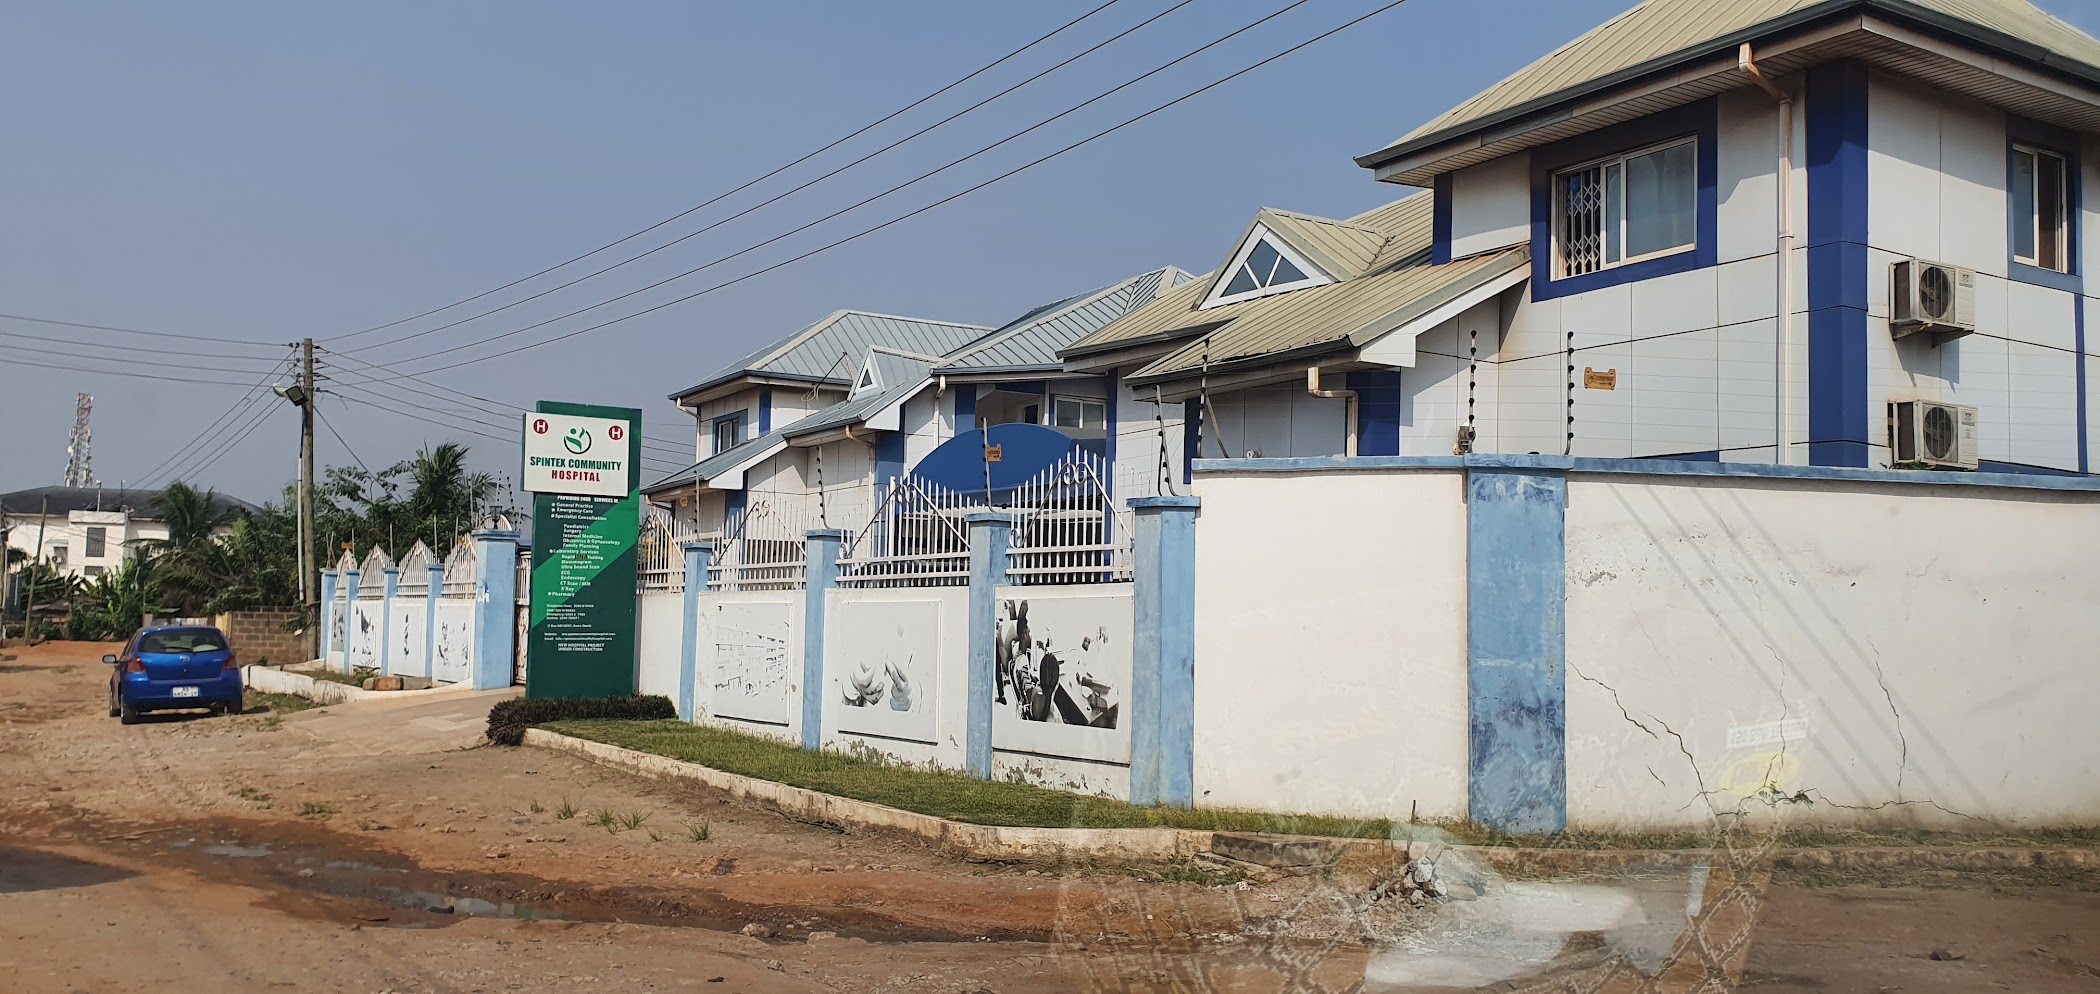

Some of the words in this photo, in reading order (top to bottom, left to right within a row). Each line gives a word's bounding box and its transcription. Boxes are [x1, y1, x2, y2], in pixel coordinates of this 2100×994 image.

[536, 421, 546, 432] H
[611, 427, 621, 438] H
[530, 456, 566, 468] SPINTEX
[568, 458, 622, 471] COMMUNITY
[551, 470, 601, 482] HOSPITAL
